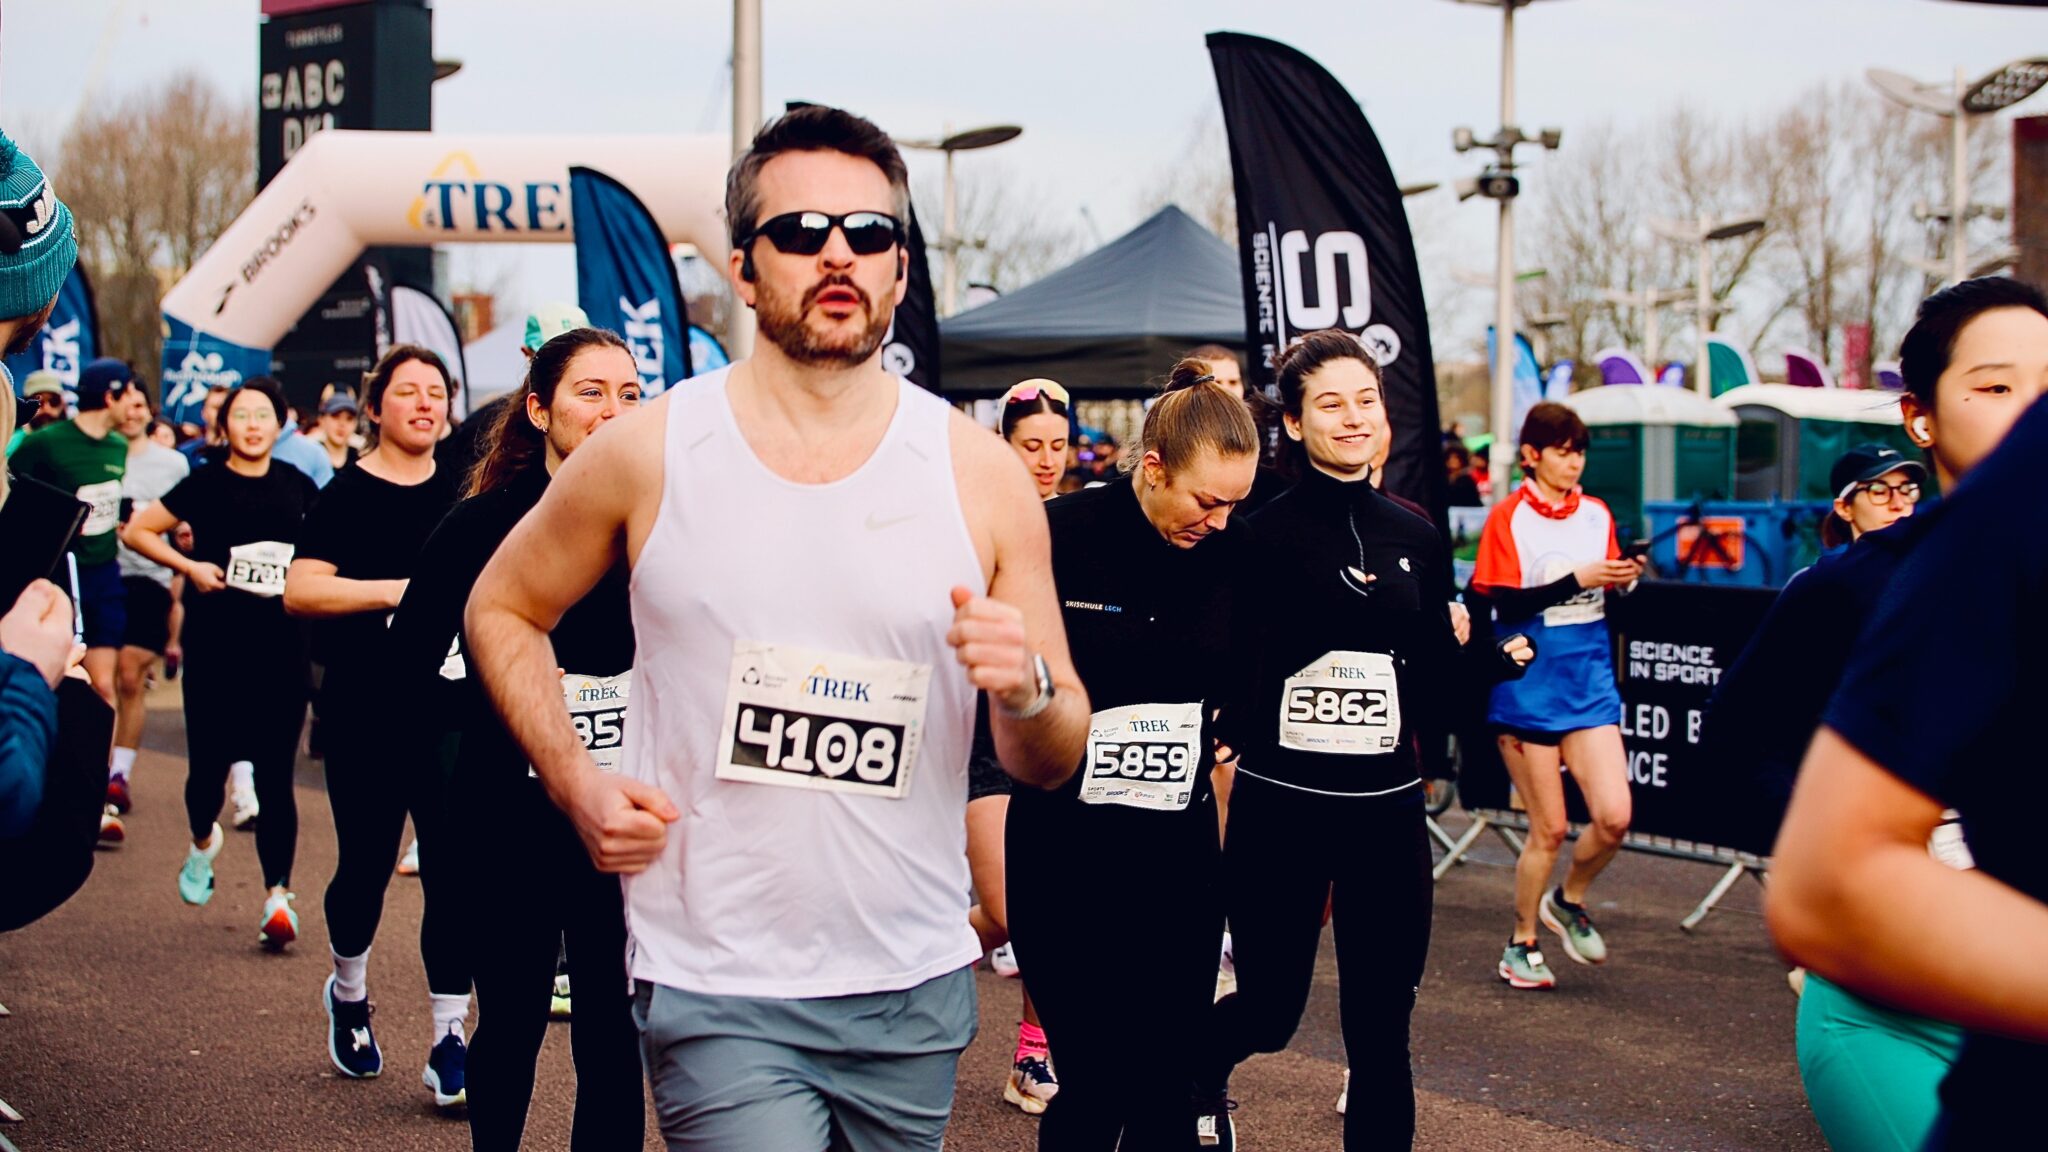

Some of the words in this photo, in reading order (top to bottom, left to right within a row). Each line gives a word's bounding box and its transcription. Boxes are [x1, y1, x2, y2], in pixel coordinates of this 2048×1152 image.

[283, 59, 345, 112] ABC
[424, 182, 566, 231] TRE
[1253, 232, 1275, 334] SCIENCE
[1065, 600, 1103, 610] SKISCHULE
[1629, 640, 1714, 665] SCIENCE
[808, 676, 872, 703] TREK
[1328, 666, 1366, 679] TREK
[1630, 661, 1650, 679] IN
[1654, 662, 1723, 685] SPORT
[579, 686, 620, 701] TREK
[1288, 689, 1388, 724] 5862
[571, 709, 627, 749] 85
[1129, 720, 1170, 732] TREK
[1620, 702, 1670, 740] LED
[1688, 709, 1702, 744] B
[738, 708, 897, 783] 4108
[1094, 743, 1189, 780] 5859
